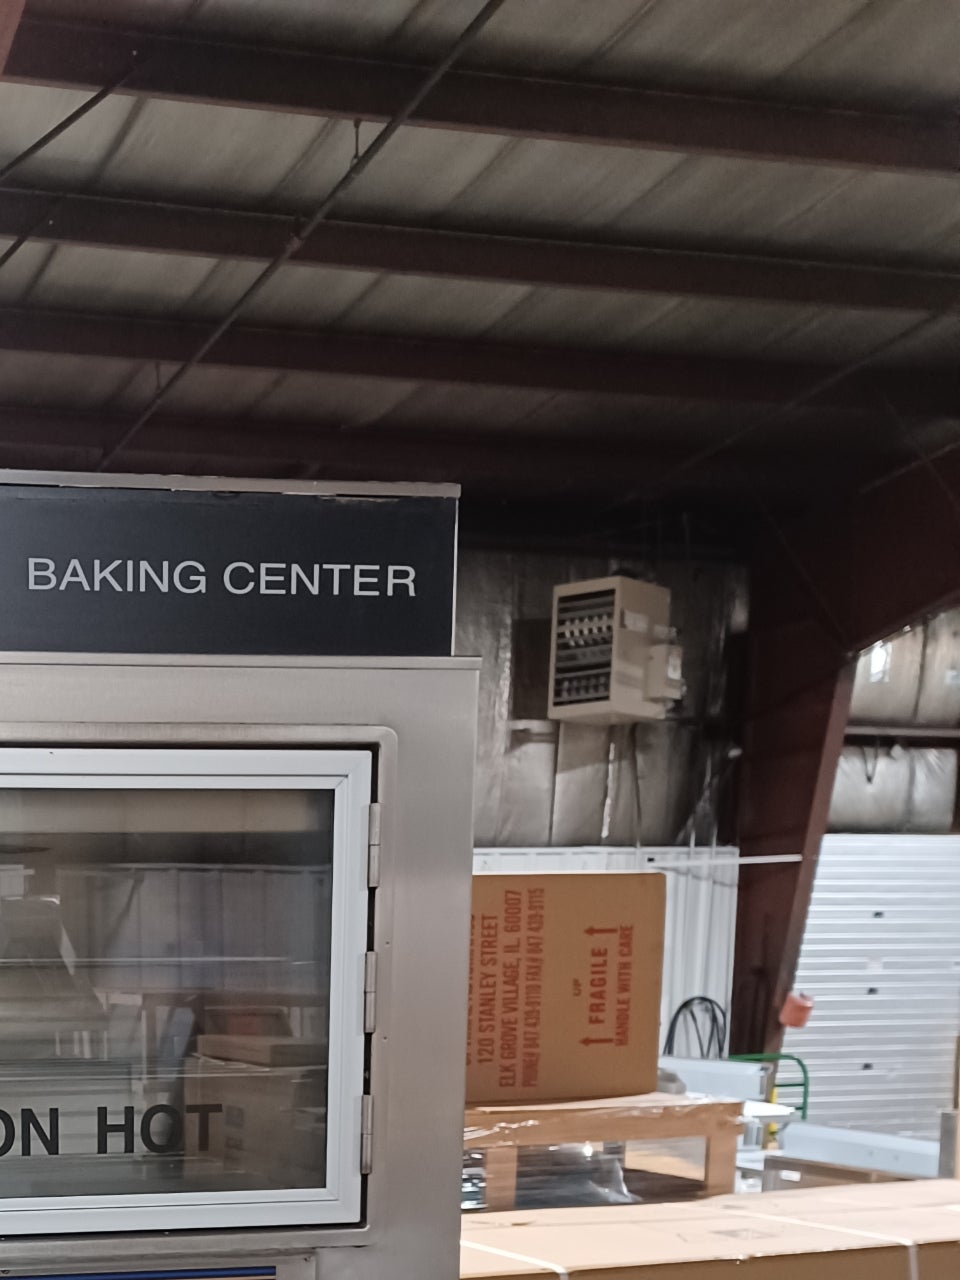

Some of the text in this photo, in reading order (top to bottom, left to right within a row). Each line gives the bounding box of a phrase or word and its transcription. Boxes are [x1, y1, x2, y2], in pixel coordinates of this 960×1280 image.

[26, 557, 418, 598] BAKING CENTER
[504, 889, 522, 932] 60007
[477, 914, 498, 1063] 120 STANLEY STREET
[588, 947, 607, 1024] FRAGILE
[615, 925, 633, 1046] HANDLE WITH CARE
[500, 1018, 518, 1059] GROVE
[499, 1063, 516, 1087] ELK
[97, 1103, 223, 1155] HOT
